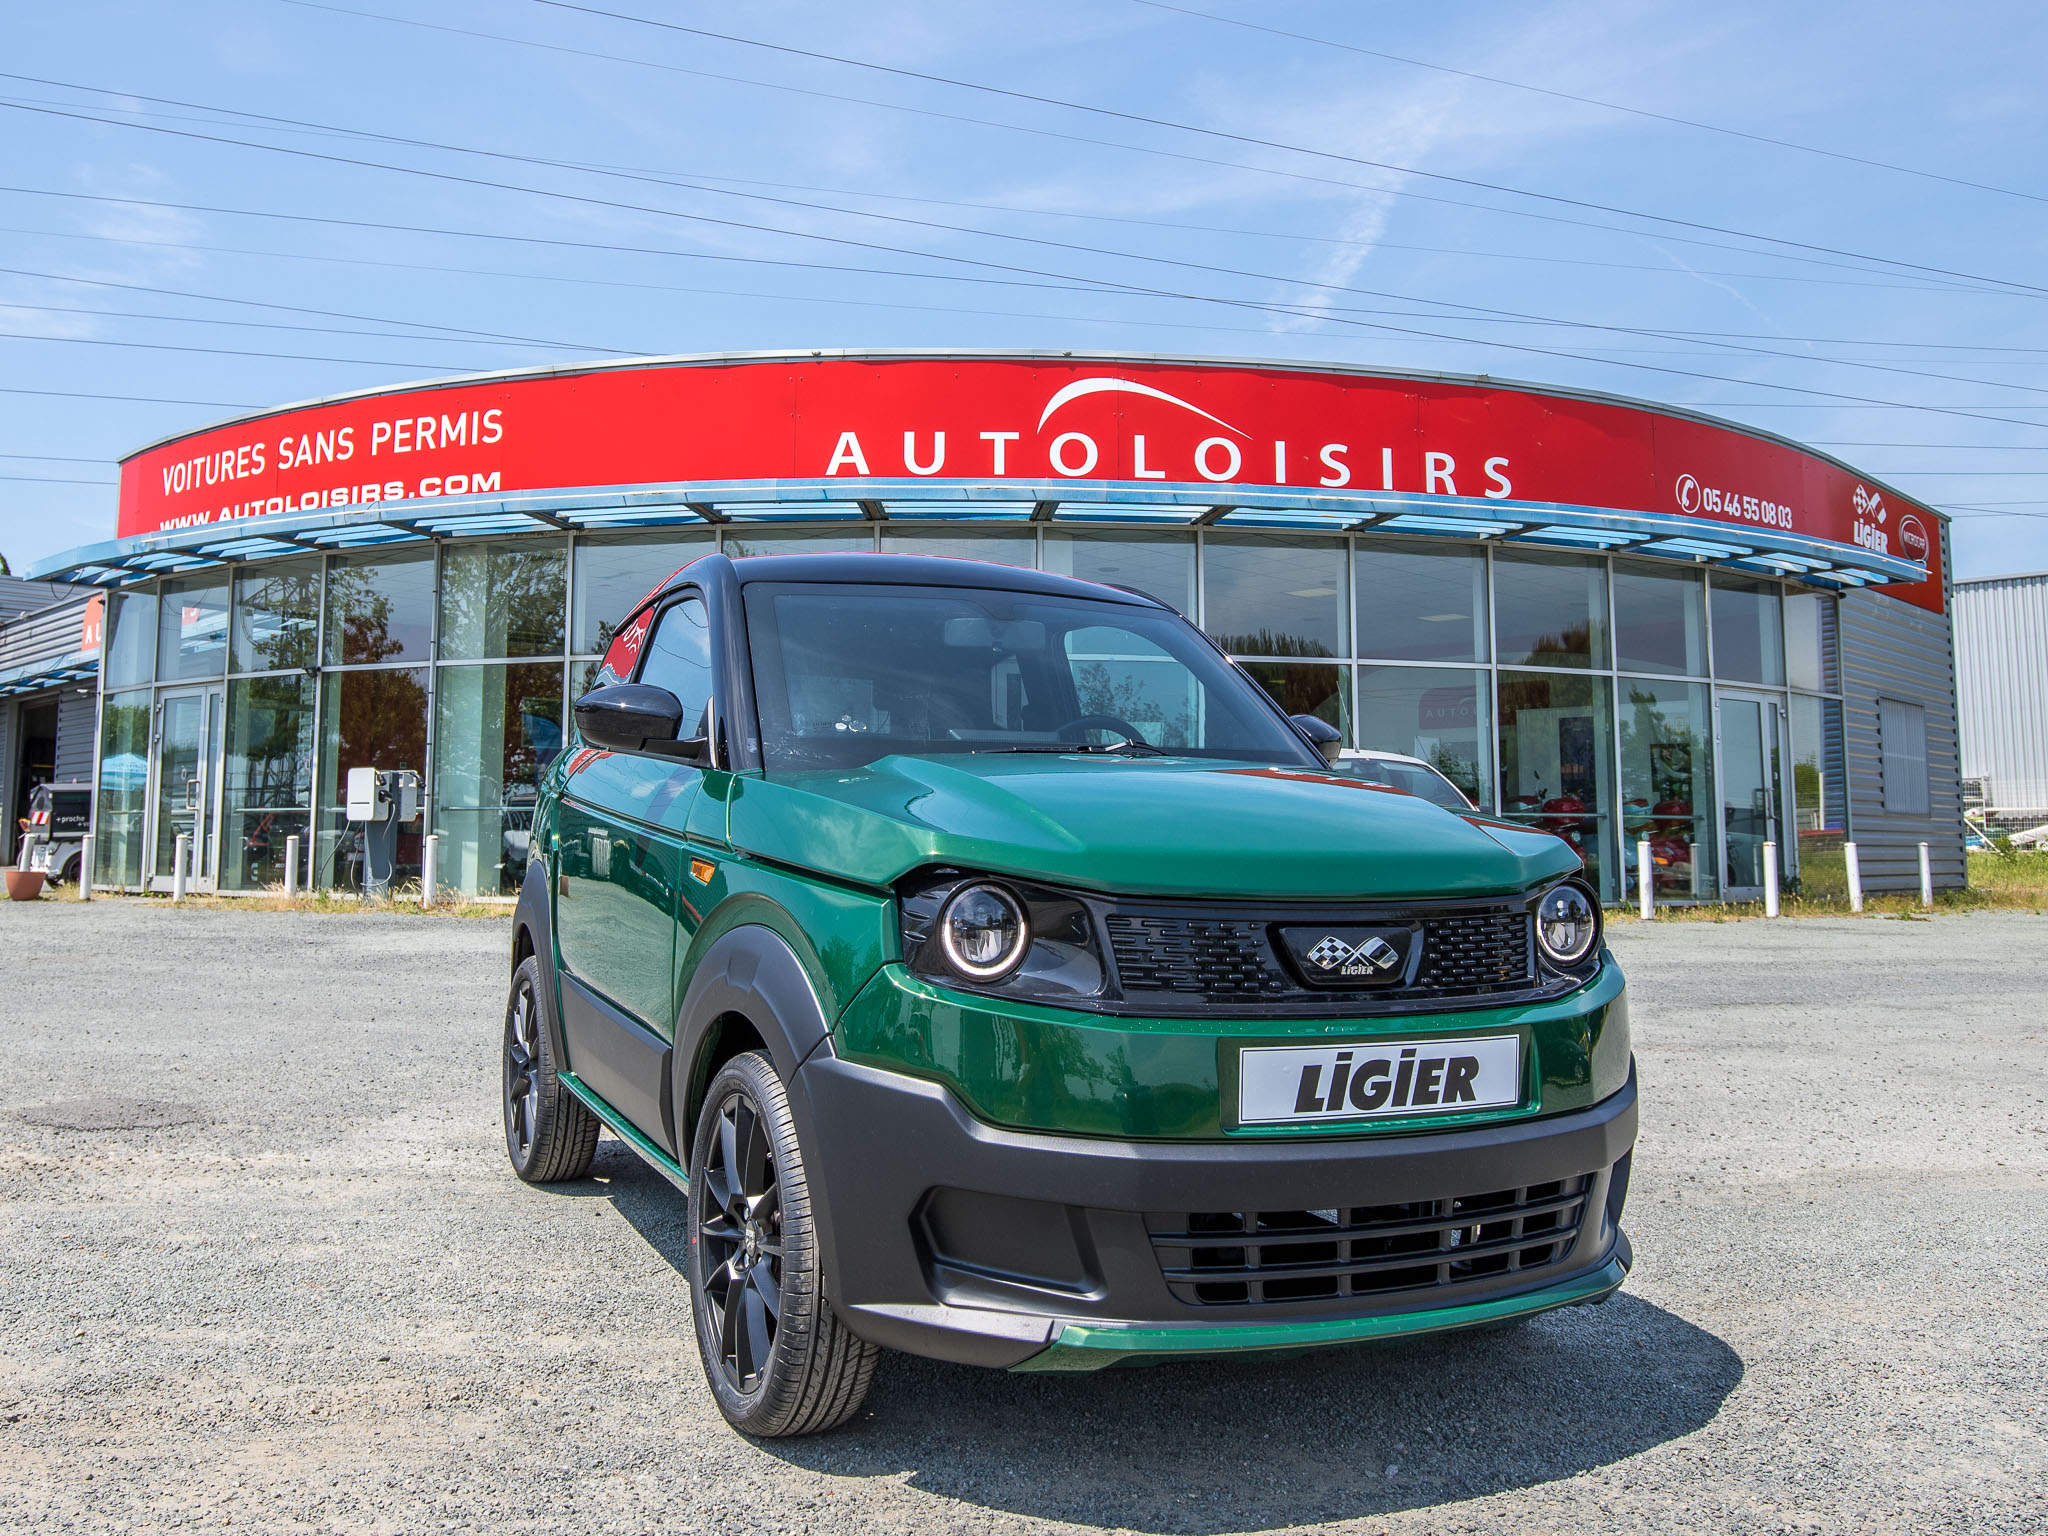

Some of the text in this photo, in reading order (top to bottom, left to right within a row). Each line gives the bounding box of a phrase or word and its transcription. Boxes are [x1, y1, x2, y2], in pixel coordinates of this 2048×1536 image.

[162, 408, 503, 497] VOITURES SANS PERMIS
[825, 430, 1513, 501] AUTOLOISIRS
[1702, 487, 1793, 530] 05 46 55 08 03
